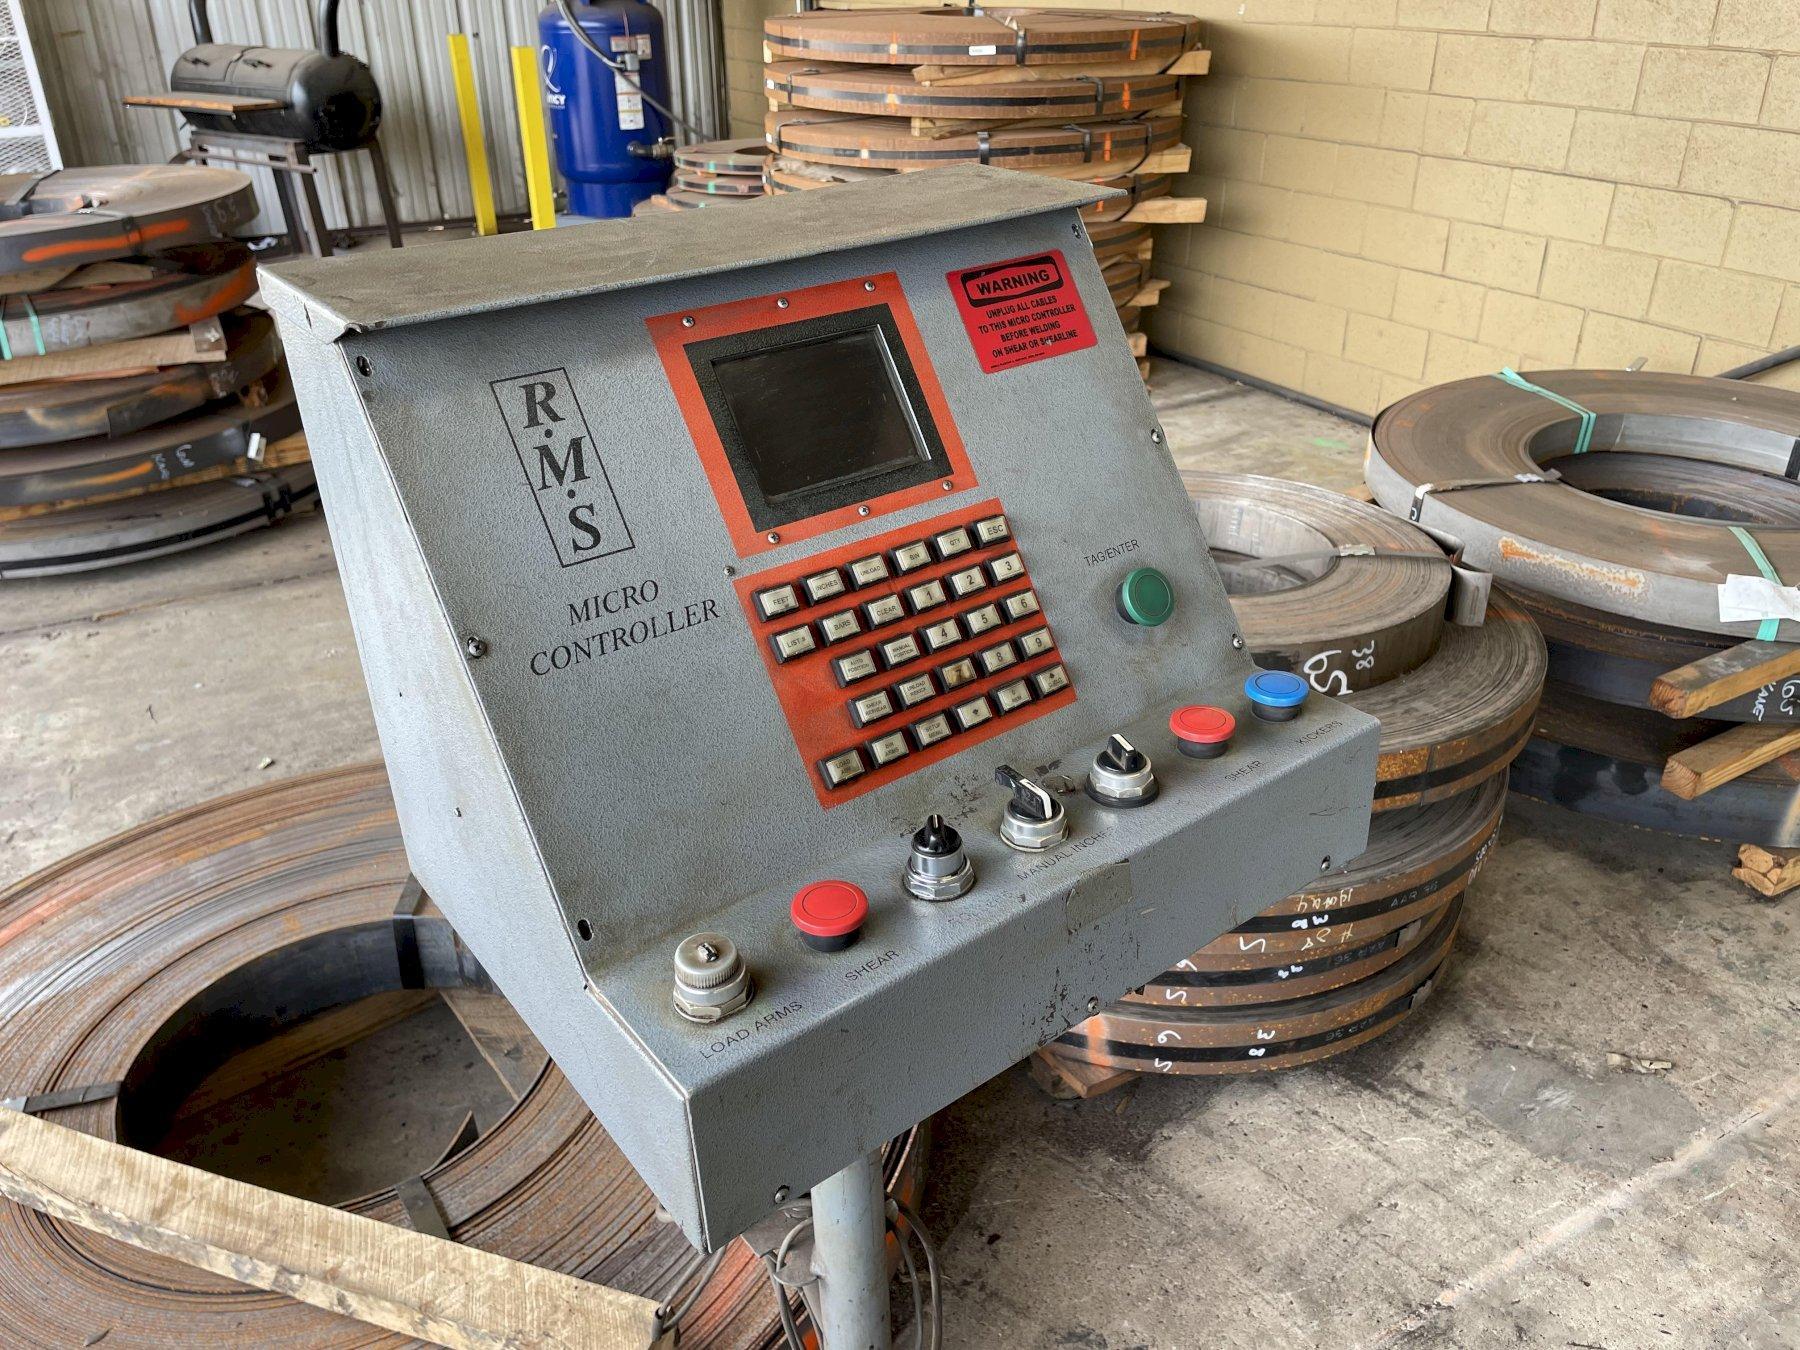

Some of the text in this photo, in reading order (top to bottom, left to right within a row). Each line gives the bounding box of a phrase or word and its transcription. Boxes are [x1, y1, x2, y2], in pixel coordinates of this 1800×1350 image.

[976, 269, 1050, 295] WARNING
[986, 295, 1058, 319] UNPLUG ALL CABLES
[978, 304, 1076, 335] TO THIS MICRO CONTROLLER
[1000, 320, 1061, 343] BEFORE WELDING
[992, 329, 1078, 358] ON SHEAR OR SHEARLINE
[987, 524, 1004, 535] ESC
[949, 538, 961, 546] QTY
[1084, 539, 1140, 566] TAG/ENTER
[860, 566, 881, 577] UNLOAD
[1005, 561, 1012, 571] 3
[815, 580, 839, 591] INCHES
[966, 574, 974, 585] 2
[773, 596, 789, 606] FEET
[926, 590, 933, 601] 1
[567, 579, 659, 626] MICRO
[1020, 598, 1027, 608] 6
[876, 606, 897, 616] CLEAR
[981, 613, 988, 624] 5
[834, 619, 851, 631] BARS
[529, 599, 720, 676] CONTROLLER
[941, 627, 948, 638] 4
[1035, 637, 1042, 648] 9
[996, 652, 1003, 662] 8
[955, 668, 963, 680] 7
[1295, 720, 1343, 746] KICKERS
[1225, 760, 1262, 782] SHEAR
[1017, 851, 1073, 880] MANUAL
[845, 950, 900, 981] SHEAR
[699, 1001, 803, 1060] LOAD ARMS
